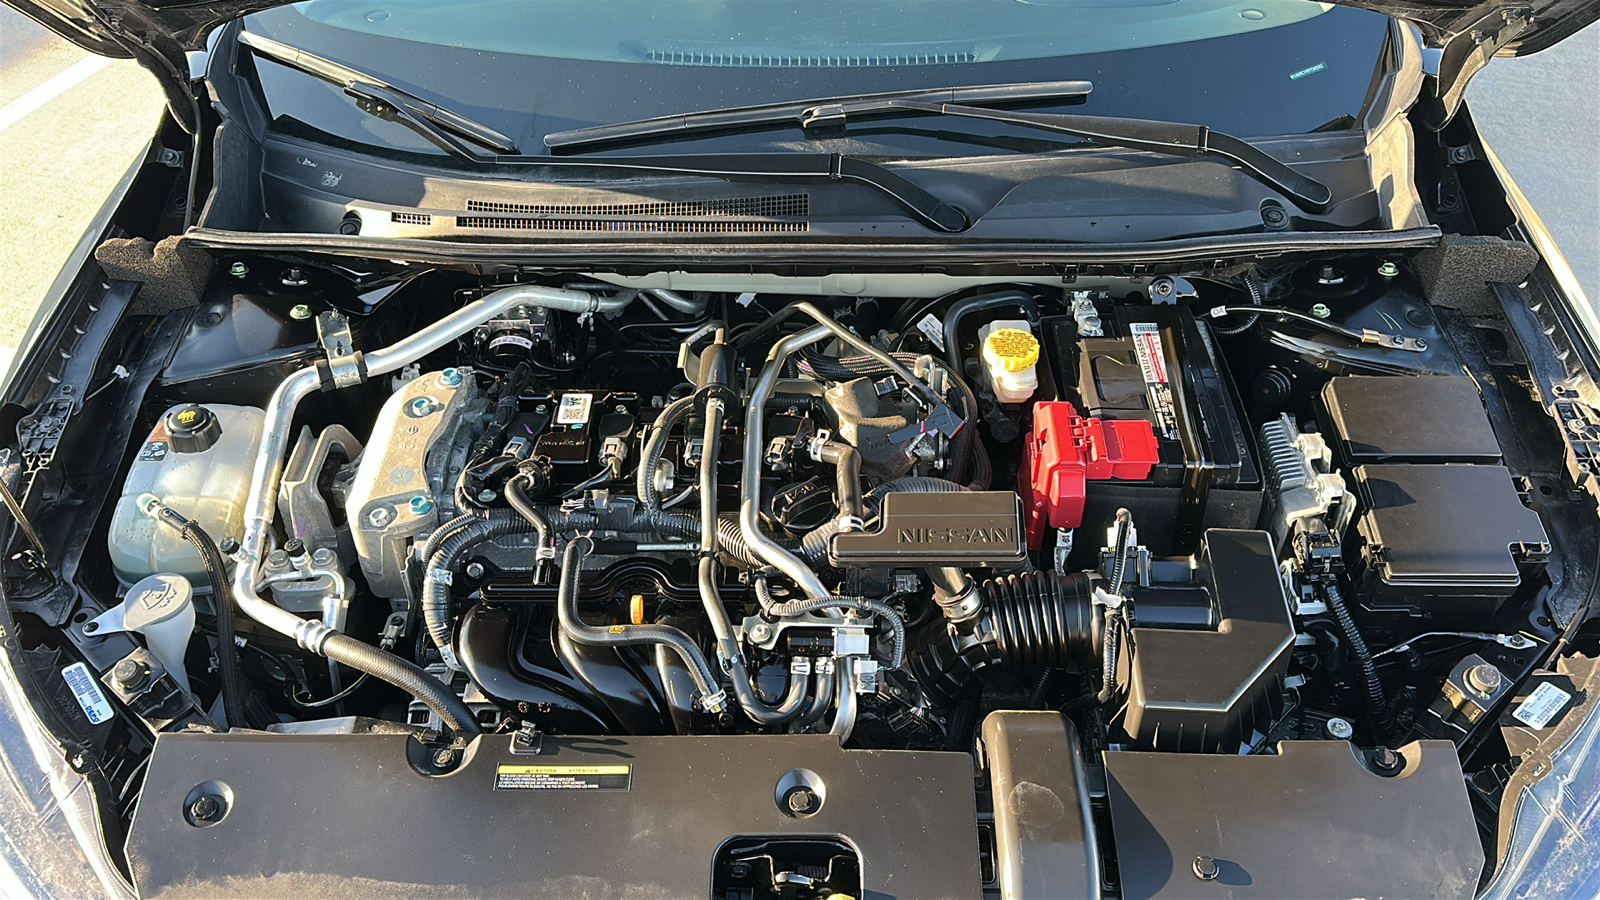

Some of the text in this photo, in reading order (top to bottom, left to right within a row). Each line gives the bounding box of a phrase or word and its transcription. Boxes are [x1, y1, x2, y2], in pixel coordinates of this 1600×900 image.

[1135, 334, 1147, 359] NISSAN
[897, 527, 1014, 543] NISSAN
[85, 705, 101, 723] DEPO
